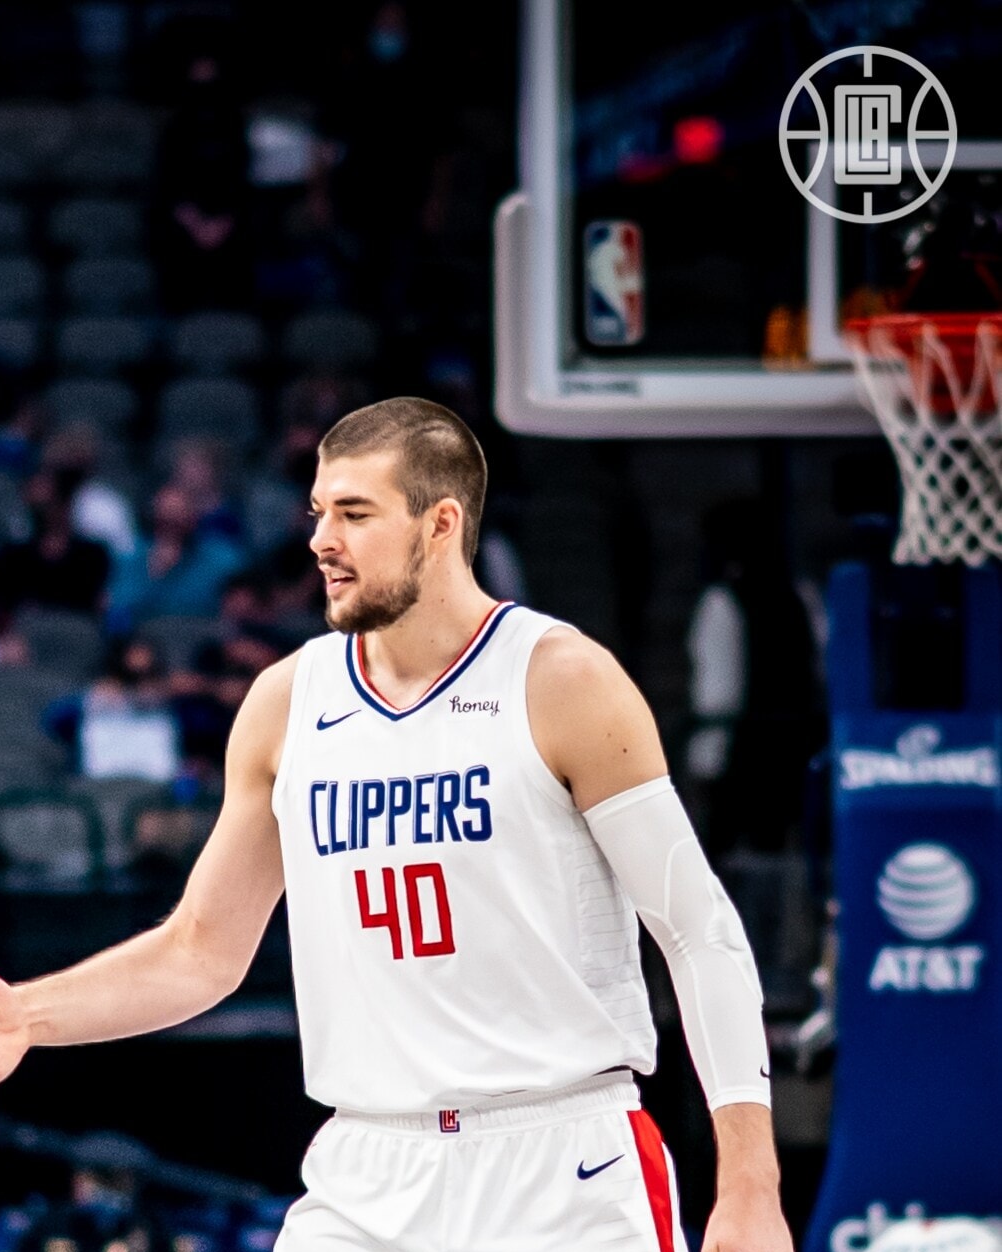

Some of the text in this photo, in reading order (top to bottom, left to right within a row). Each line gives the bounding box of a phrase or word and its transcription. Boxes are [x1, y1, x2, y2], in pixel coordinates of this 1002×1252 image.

[448, 695, 501, 717] honey
[309, 764, 493, 857] CLIPPERS
[354, 862, 457, 960] 40
[869, 946, 985, 991] AT&T
